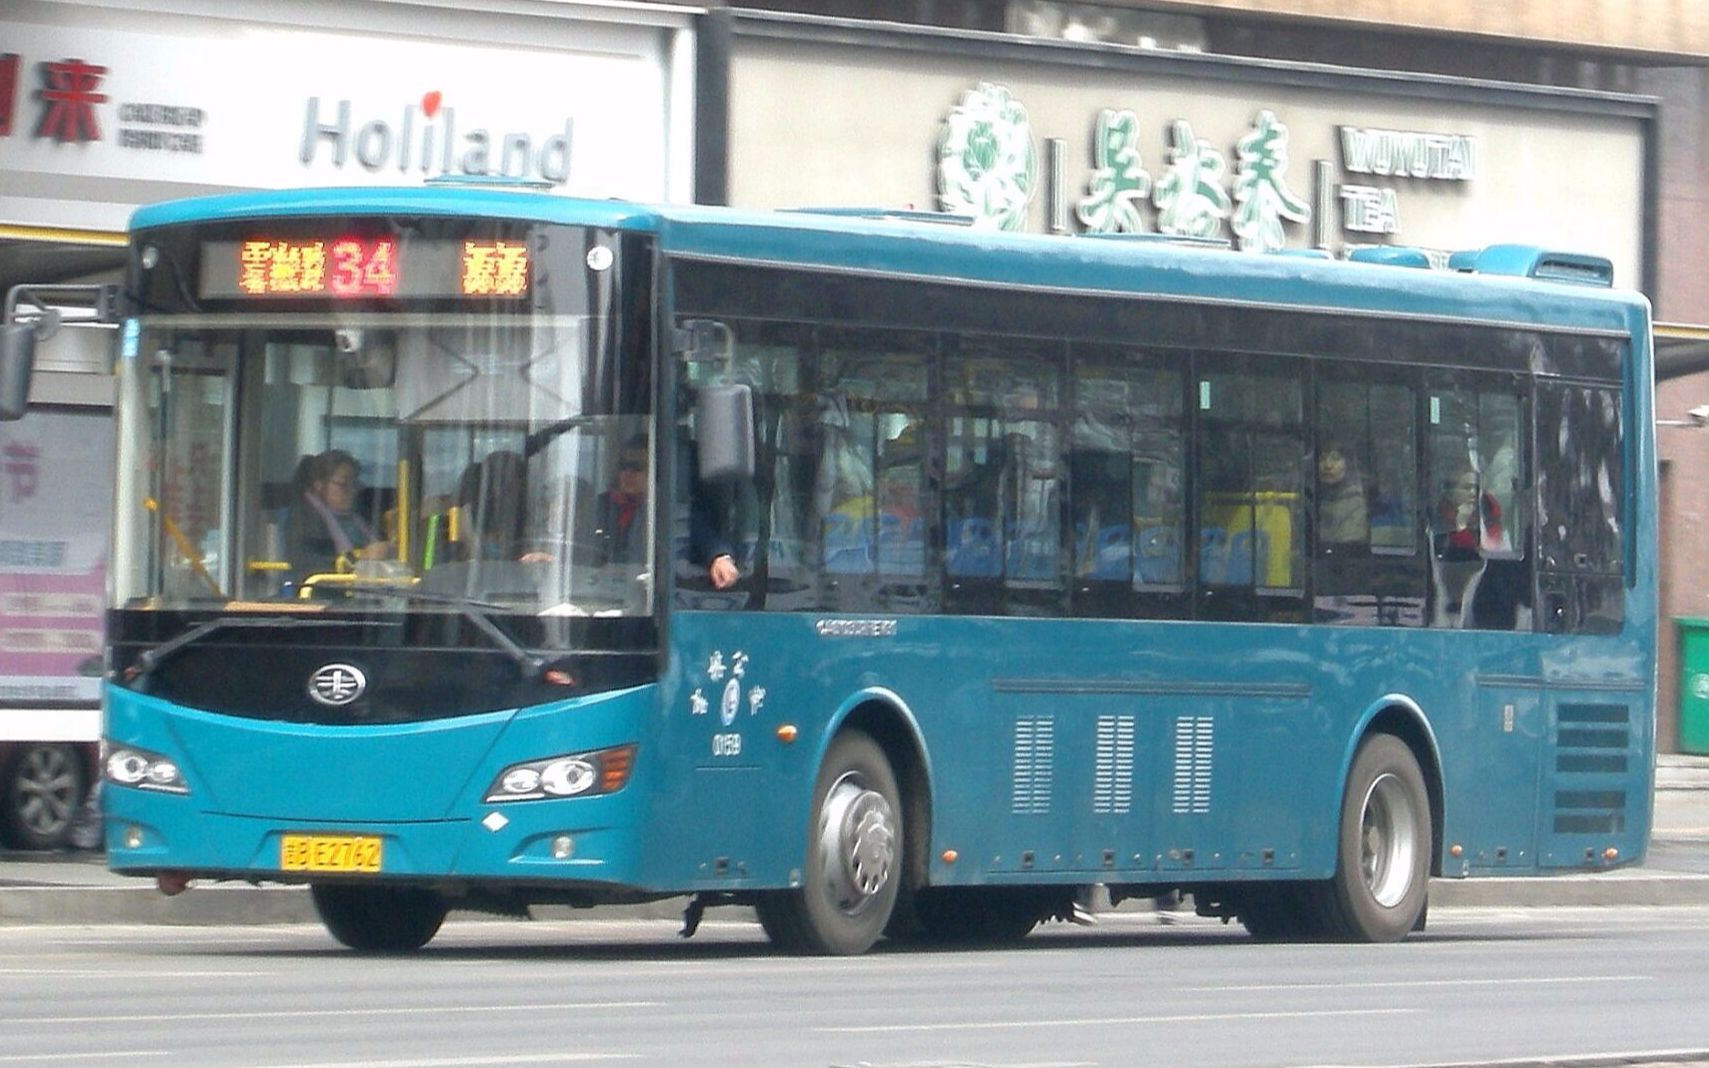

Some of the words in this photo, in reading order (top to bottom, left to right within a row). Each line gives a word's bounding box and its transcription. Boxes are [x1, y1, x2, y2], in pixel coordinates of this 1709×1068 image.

[299, 90, 575, 184] Holiland
[1341, 185, 1401, 234] TEA
[332, 241, 397, 295] 34
